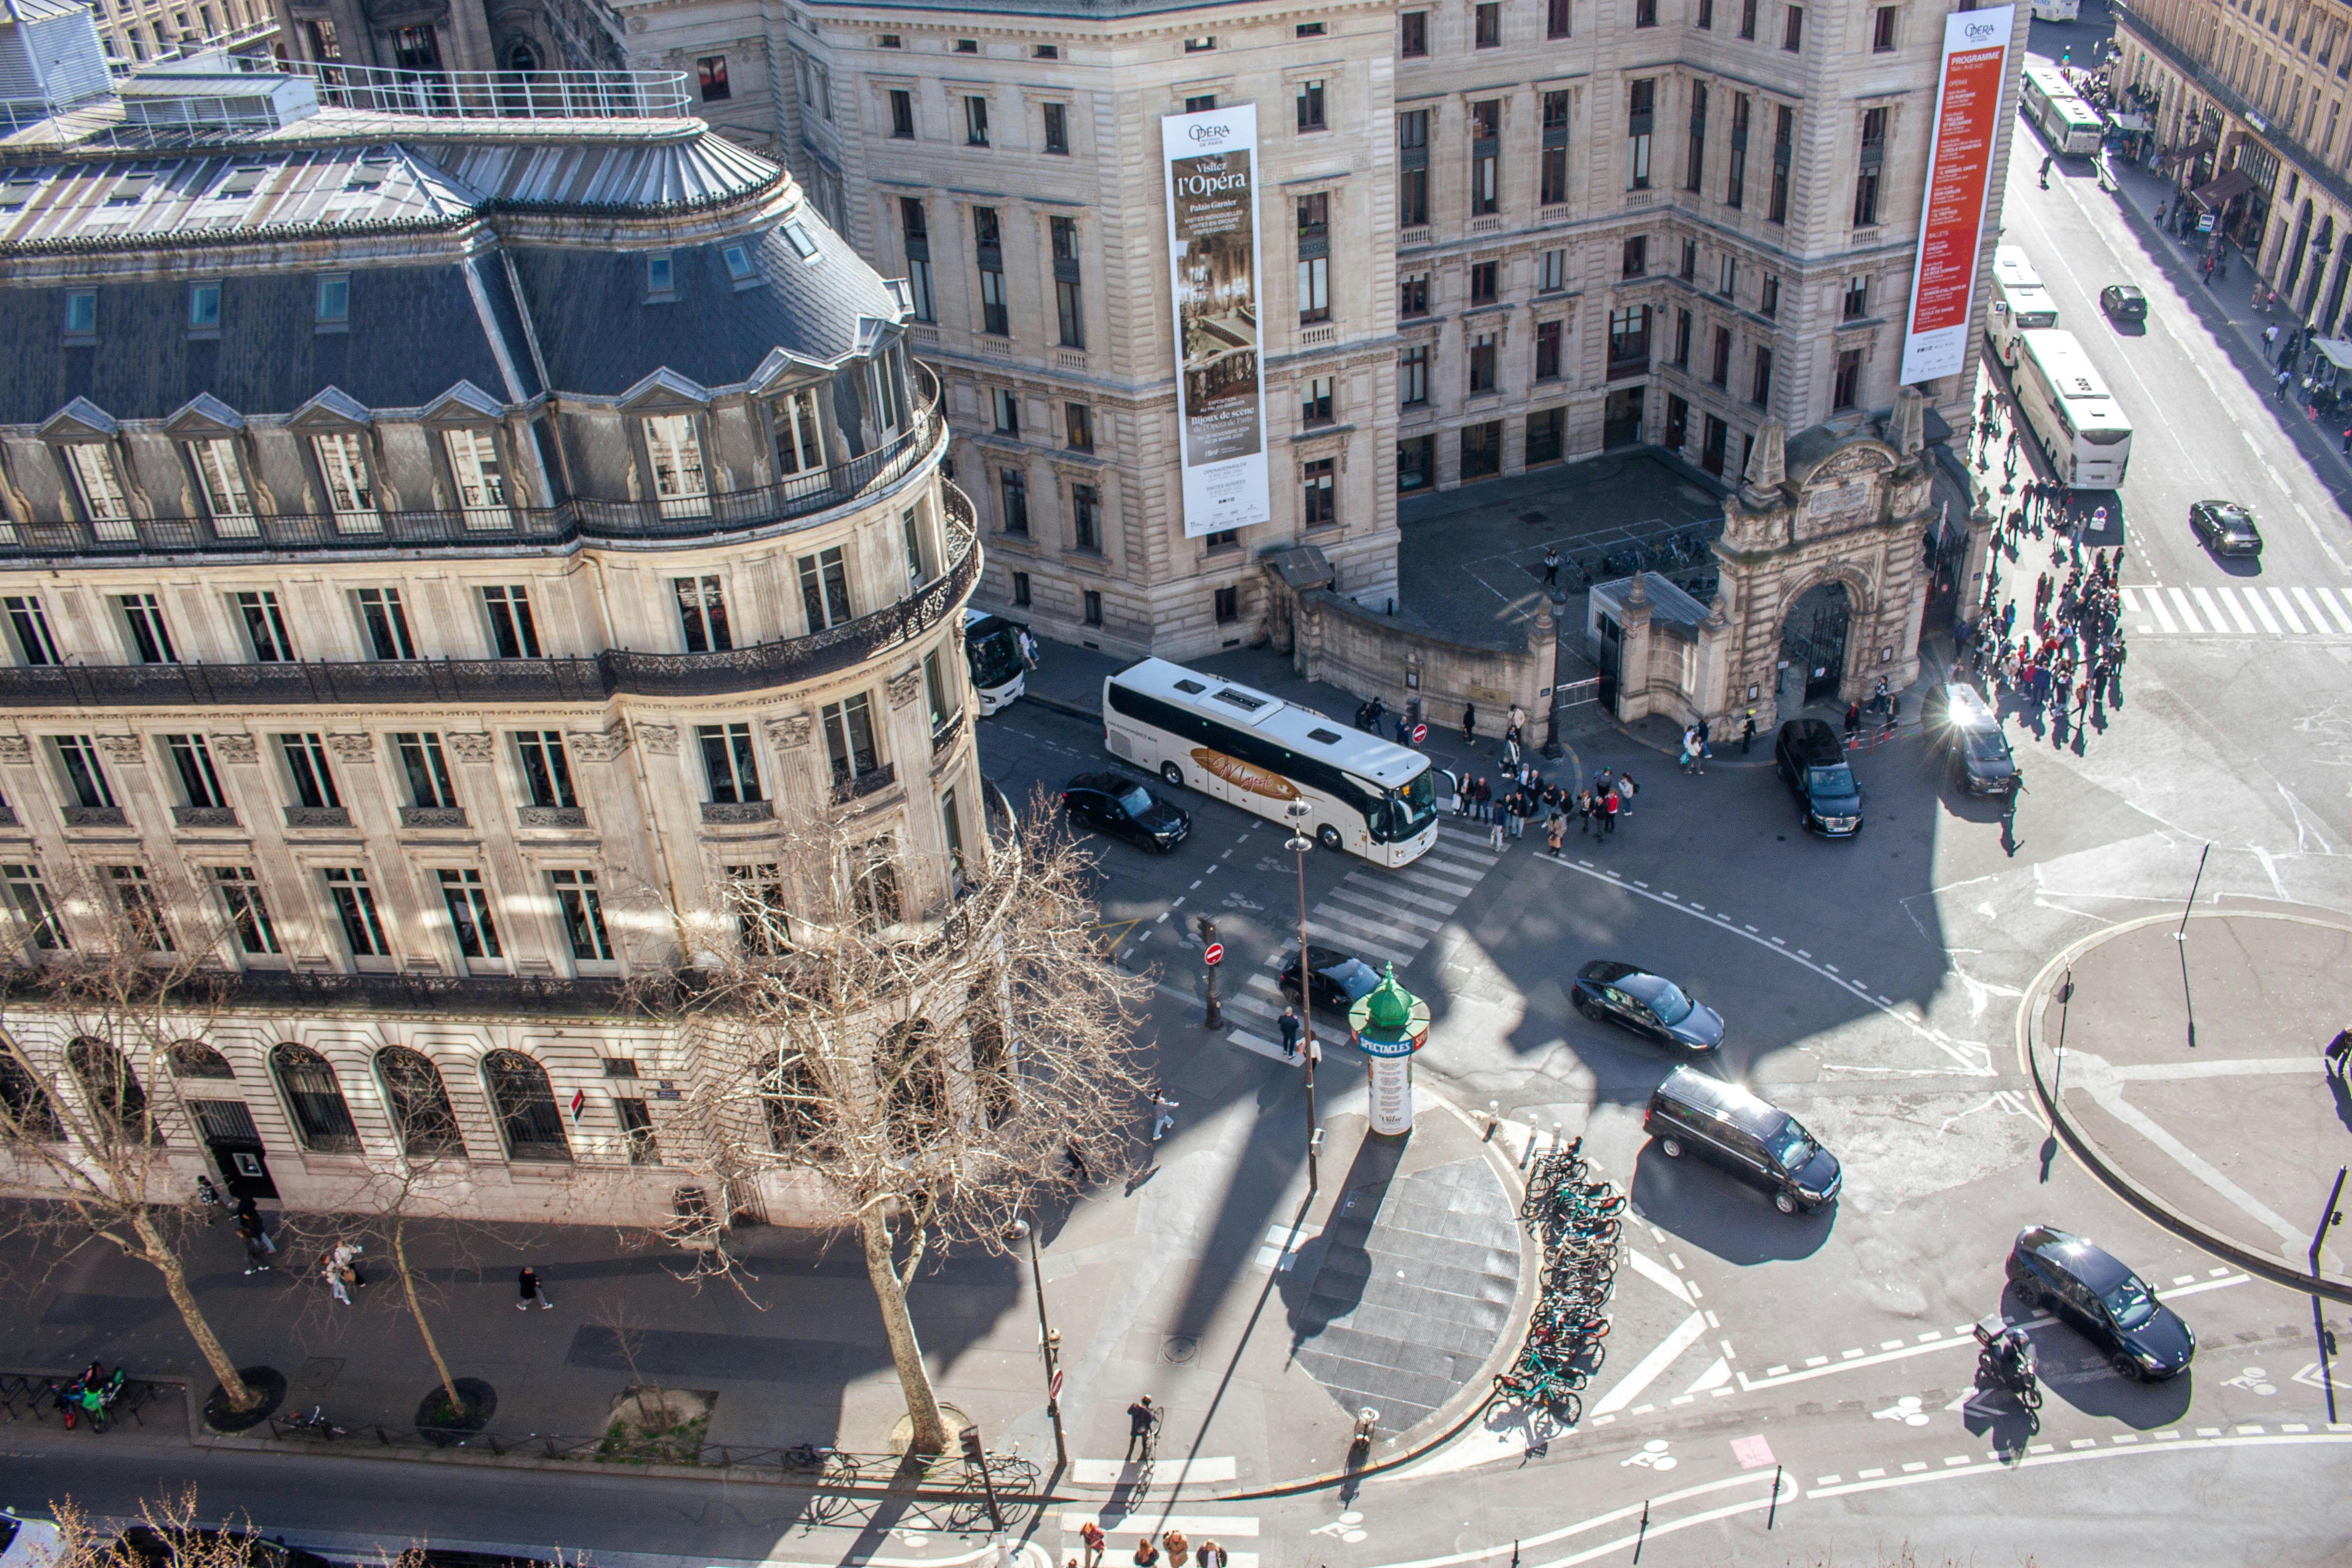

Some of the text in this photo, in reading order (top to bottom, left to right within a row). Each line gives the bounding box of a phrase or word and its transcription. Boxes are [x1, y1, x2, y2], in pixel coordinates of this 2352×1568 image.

[1951, 50, 2001, 65] PROGRAMME
[1189, 124, 1230, 142] OPÉRA
[1196, 161, 1228, 173] Visitez
[1177, 171, 1247, 196] l'Opéra
[1190, 199, 1237, 213] Palais Garnier
[1191, 406, 1255, 426] Bijoux de scène
[1360, 1037, 1411, 1054] SPECTACLES
